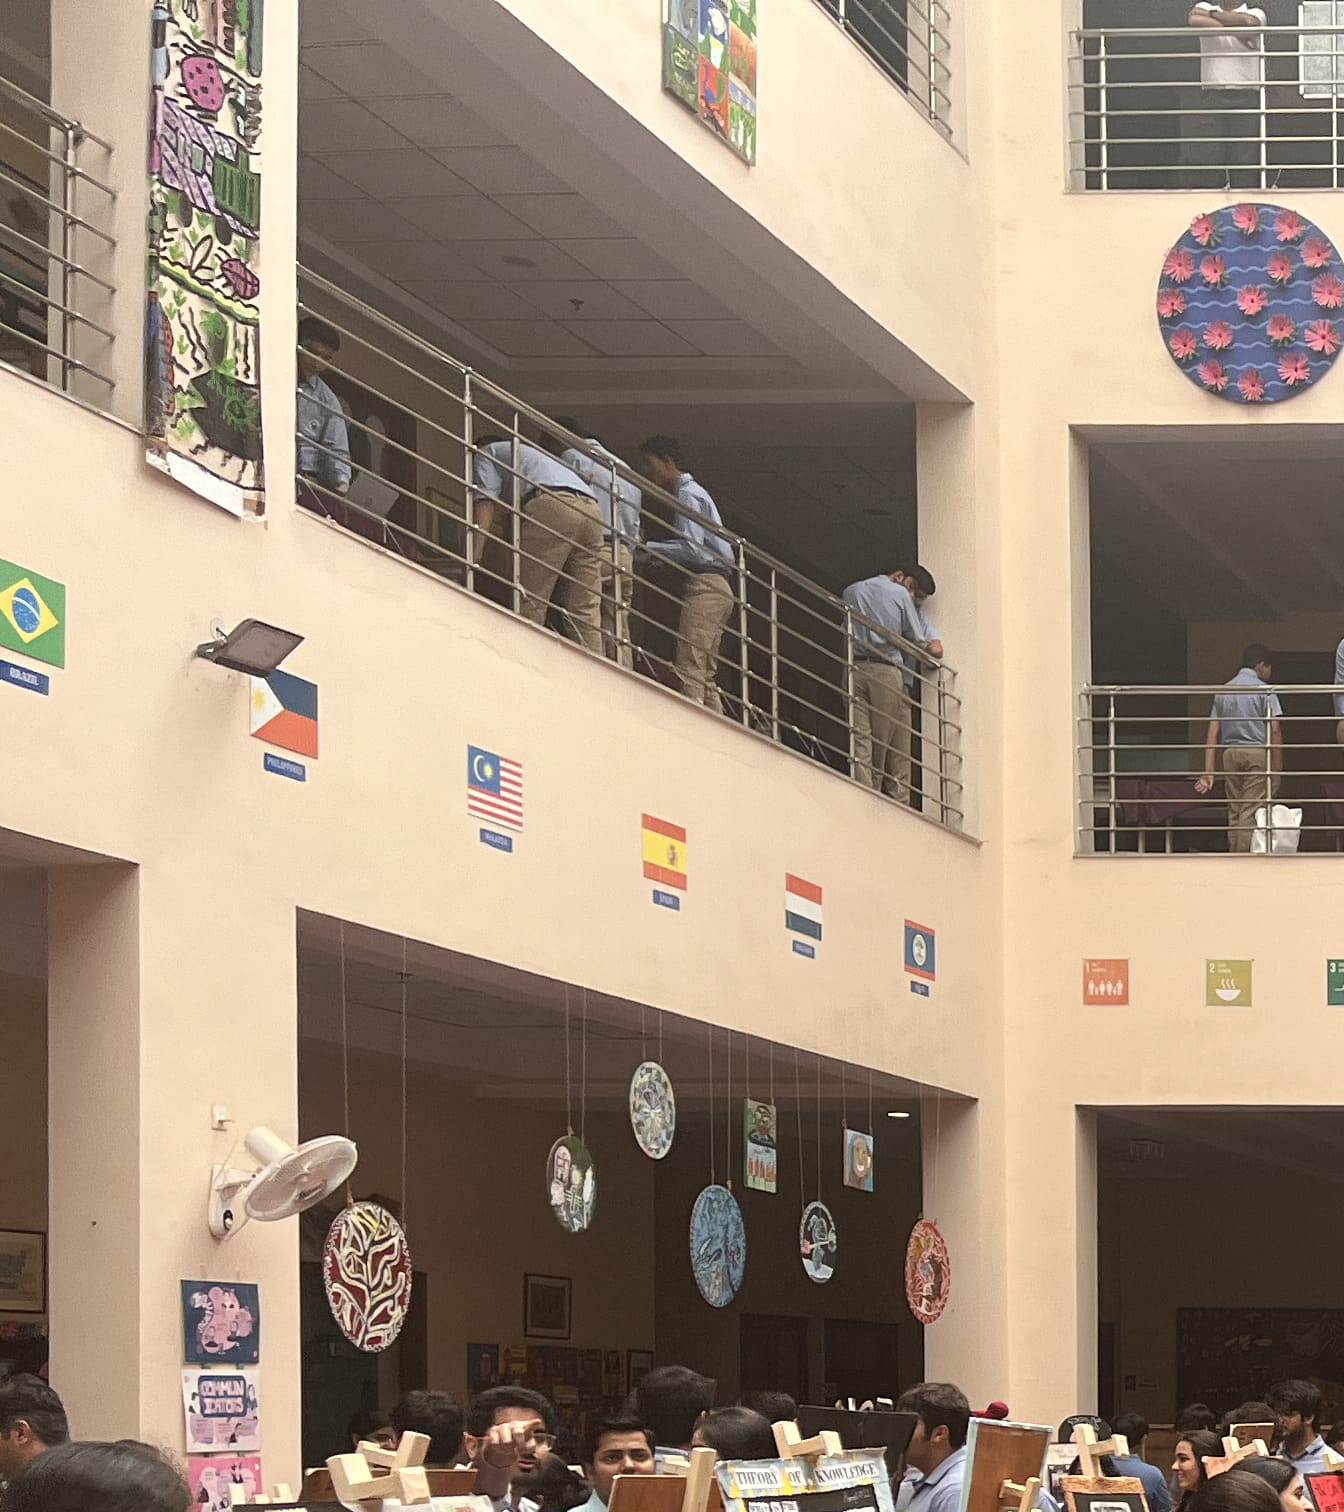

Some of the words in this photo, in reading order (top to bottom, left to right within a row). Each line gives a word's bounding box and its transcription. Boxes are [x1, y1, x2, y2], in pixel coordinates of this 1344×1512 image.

[10, 666, 39, 685] BRAZIL
[737, 1471, 778, 1486] THEORY
[788, 1470, 801, 1483] OF
[816, 1463, 877, 1483] KNOWLEDGE
